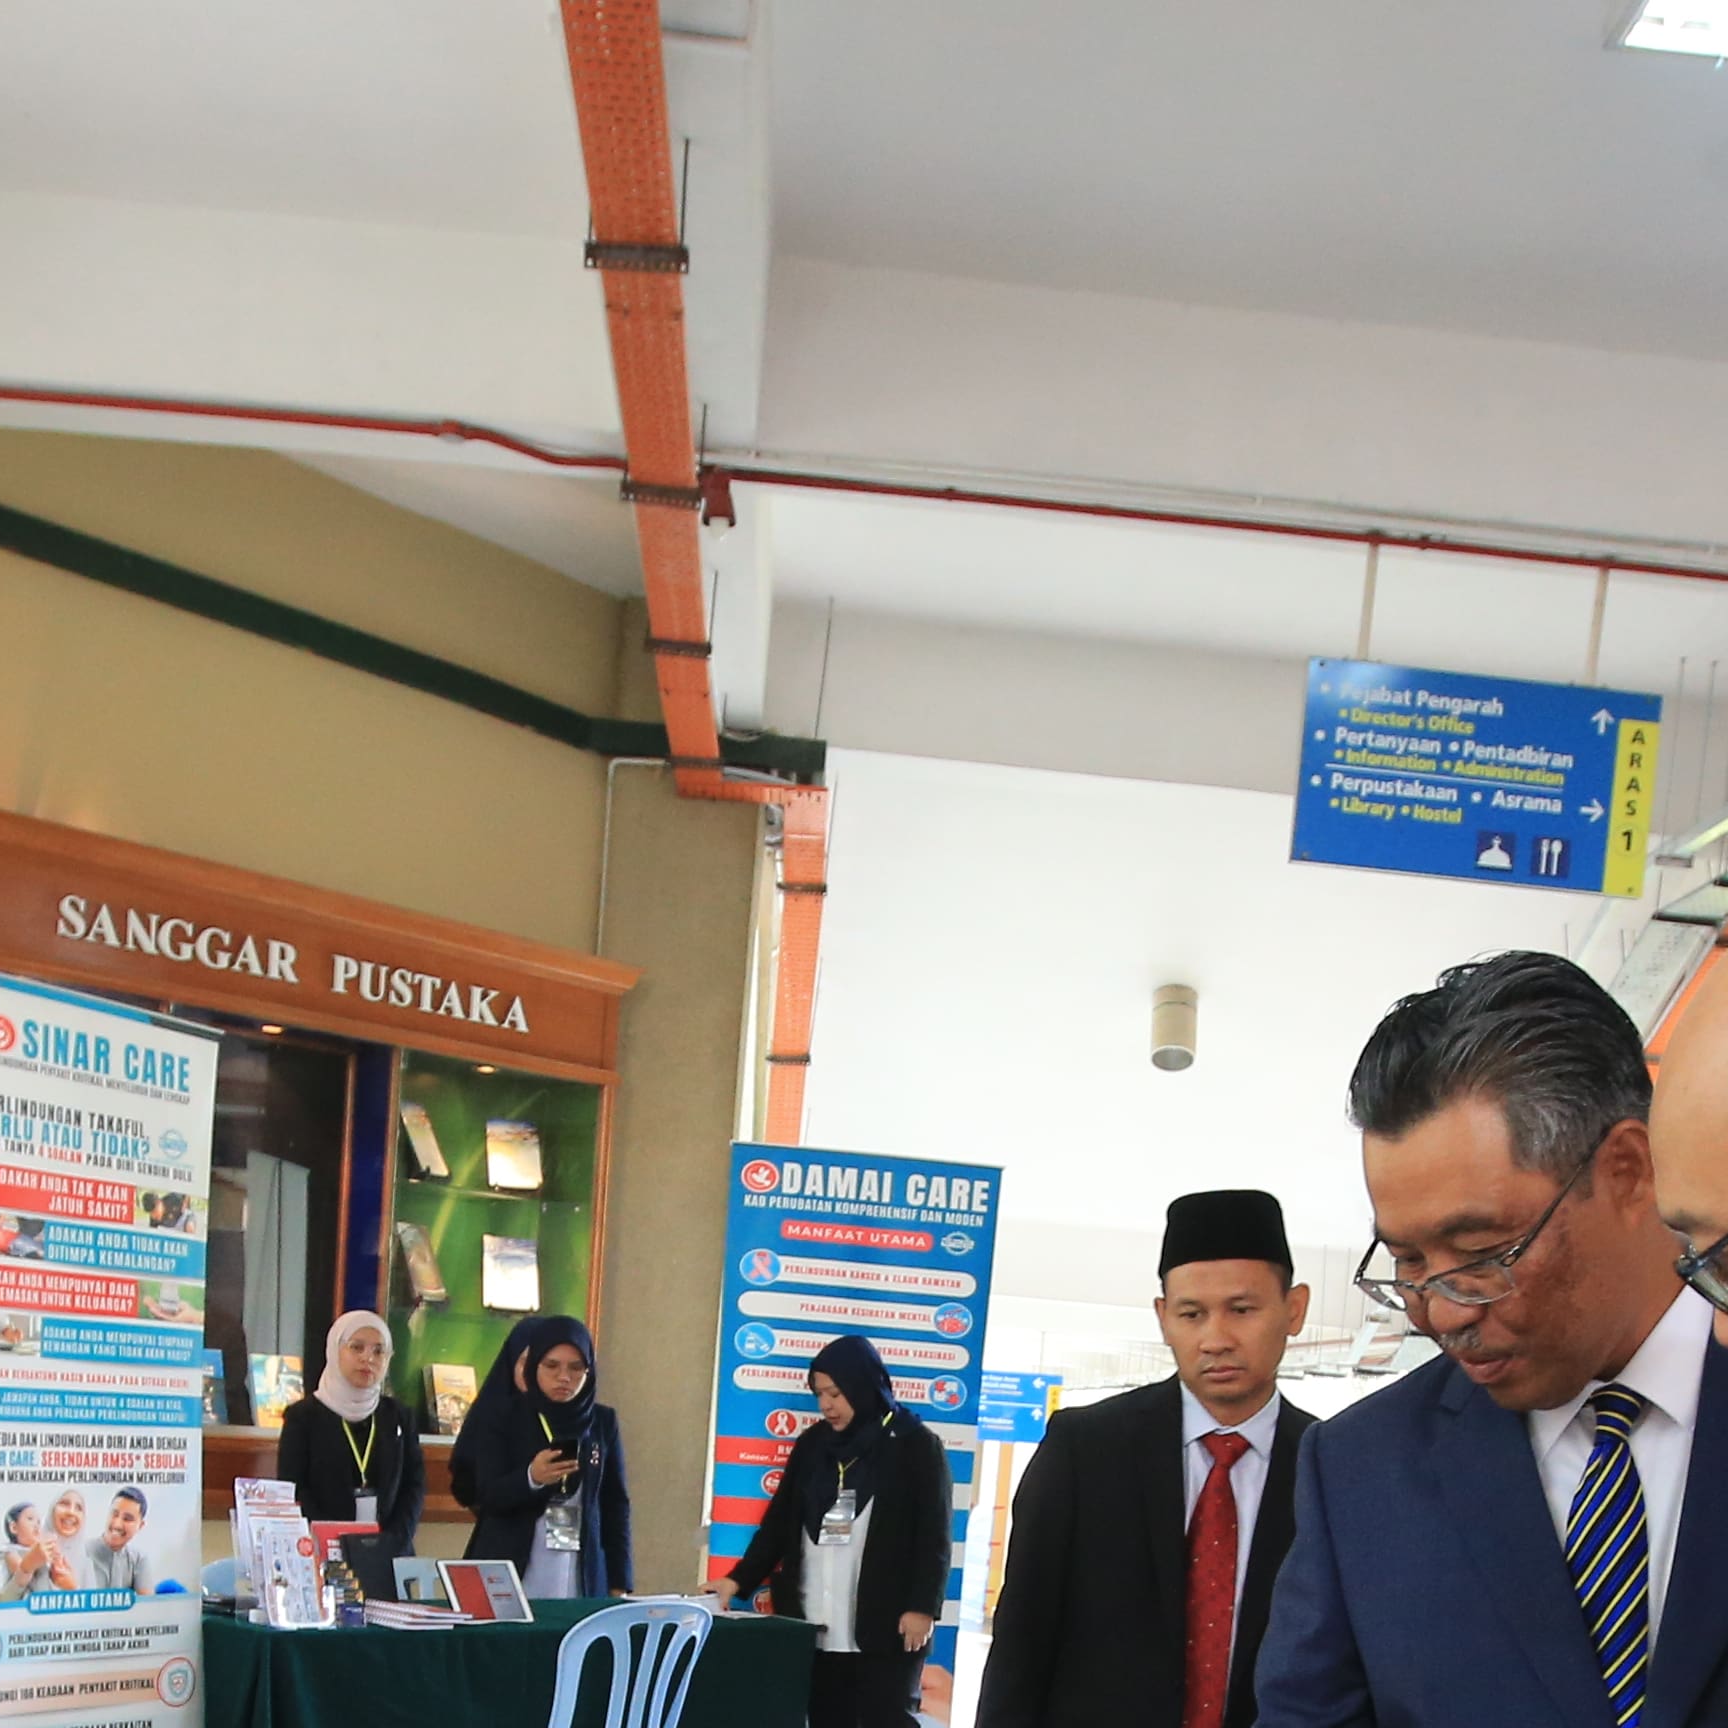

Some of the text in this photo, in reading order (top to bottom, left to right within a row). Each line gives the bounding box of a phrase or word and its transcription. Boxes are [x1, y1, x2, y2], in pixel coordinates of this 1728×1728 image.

[1340, 684, 1503, 715] Pejabat Pengarah
[1350, 707, 1474, 734] Director's Office
[1335, 727, 1574, 768] Pertanyaan Pentadbiran
[1346, 749, 1564, 785] Information Administration
[1331, 772, 1562, 813] Perpustakaan Asrama
[1341, 797, 1462, 823] Library Hostel
[1621, 831, 1633, 852] 1
[57, 894, 529, 1033] SANGGAR PUSTAKA
[23, 1019, 190, 1092] SINAR CARE
[42, 1123, 82, 1149] ATAU
[92, 1131, 150, 1159] TIDAK?
[40, 1175, 68, 1193] ANDA
[71, 1180, 92, 1196] TAK
[97, 1185, 128, 1201] AKAN
[782, 1162, 990, 1212] DAMAI CARE
[49, 1196, 127, 1219] JATUH SAKIT?
[744, 1194, 983, 1227] KAD PERUBATAN KOMPREHENSIF DAN MODEN
[48, 1225, 188, 1257] ADAKAH ANDA TIDAK AKAN
[788, 1225, 926, 1247] MANFAAT UTAMA
[48, 1244, 175, 1272] DITIMPA KEMALANGAN?
[31, 1593, 131, 1610] MANFAAT UTAMA
